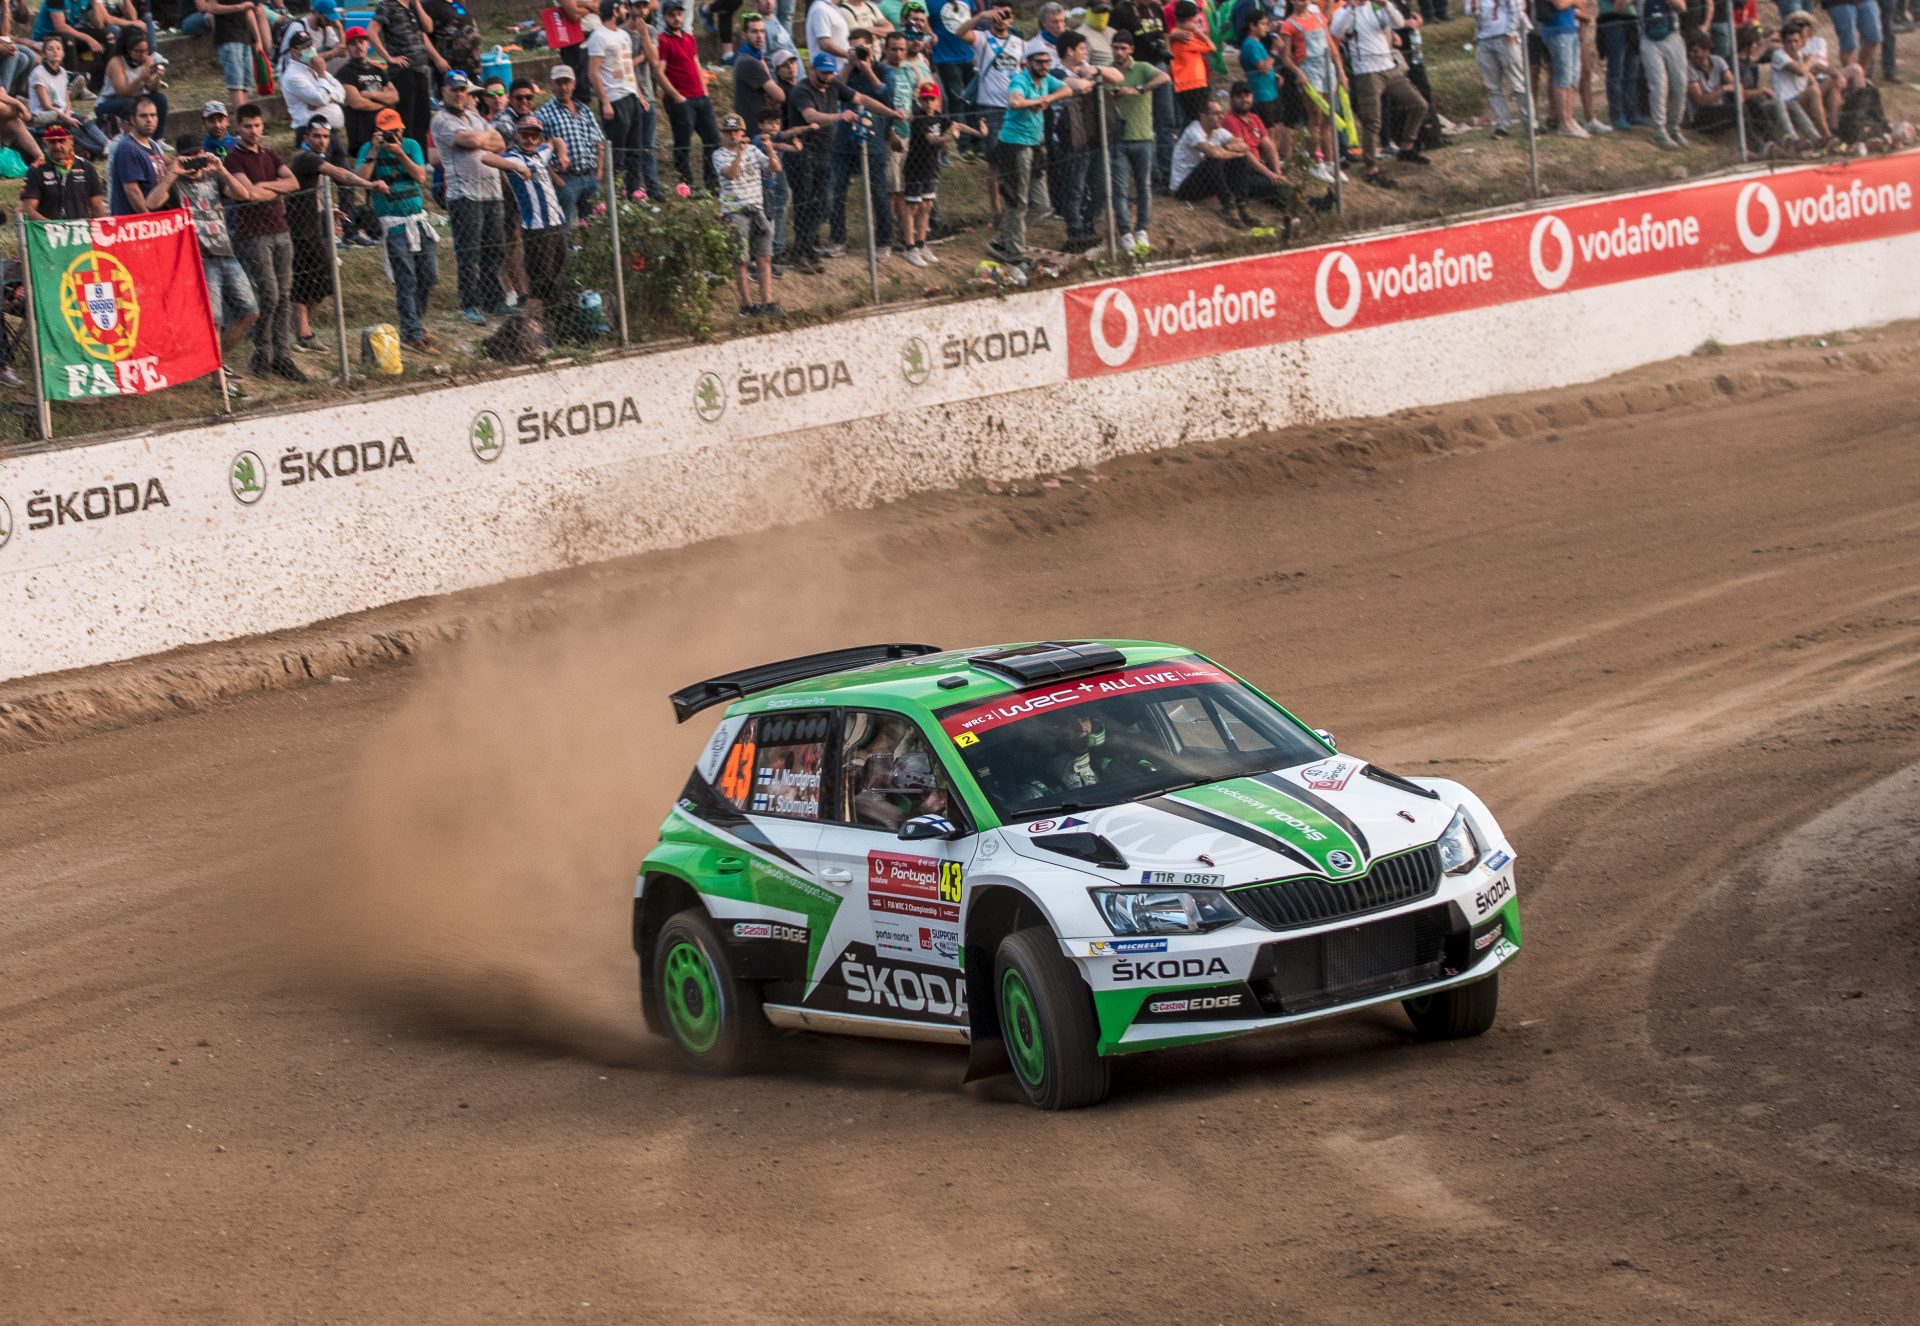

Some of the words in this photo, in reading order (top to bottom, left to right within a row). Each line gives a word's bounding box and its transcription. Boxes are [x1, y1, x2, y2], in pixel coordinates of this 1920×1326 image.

[1785, 179, 1912, 228] vodafone
[1577, 212, 1700, 263] vodafone
[1366, 248, 1493, 301] vodafone
[1143, 284, 1277, 338] vodafone
[942, 326, 1051, 370] ŠKODA
[64, 356, 167, 397] FAFE
[737, 359, 854, 406] ŠKODA
[516, 396, 642, 445] ŠKODA
[280, 436, 415, 487] ŠKODA
[27, 477, 170, 531] ŠKODA
[962, 716, 986, 729] WRC
[985, 713, 994, 721] 2
[1099, 679, 1136, 693] ALL
[1134, 671, 1180, 686] LIVE
[961, 735, 974, 745] 2
[722, 742, 756, 799] 43
[1265, 807, 1328, 841] ŠKODA
[890, 867, 937, 885] Portugal
[941, 862, 961, 902] 43
[1155, 872, 1175, 883] 11R
[1184, 874, 1218, 885] 0367
[1475, 876, 1511, 915] ŠKODA
[887, 901, 895, 909] FIA
[895, 902, 905, 911] WRC
[908, 904, 937, 916] Championship
[772, 925, 807, 944] EDGE
[931, 929, 959, 942] SUPPORT
[1117, 941, 1167, 950] MICHELIN
[1112, 957, 1230, 982] ŠKODA
[1159, 1001, 1186, 1011] Castrol
[1189, 994, 1242, 1010] EDGE
